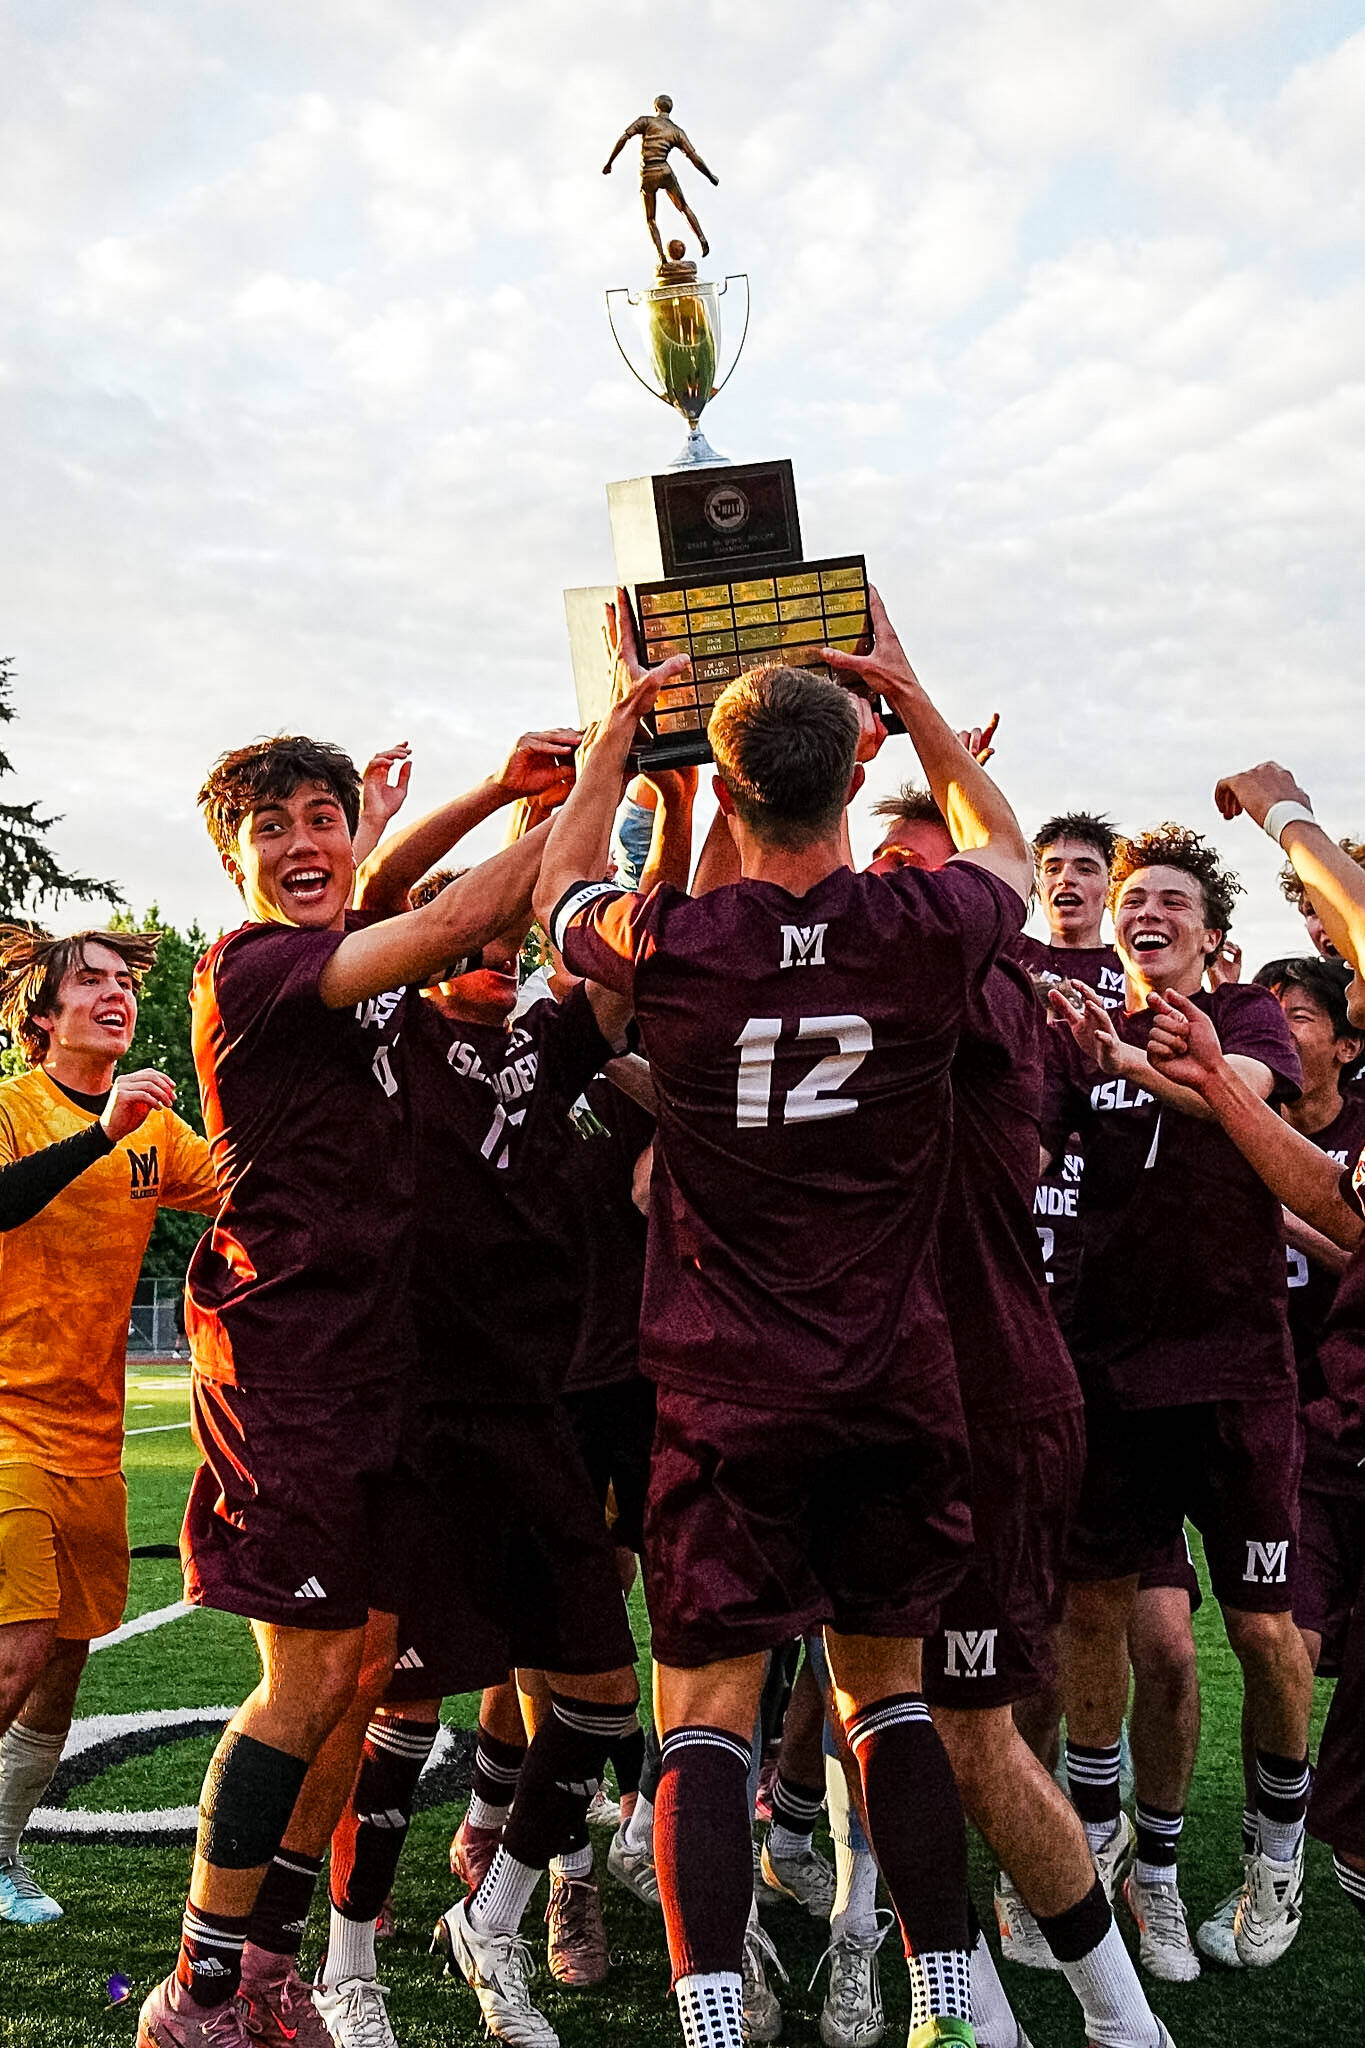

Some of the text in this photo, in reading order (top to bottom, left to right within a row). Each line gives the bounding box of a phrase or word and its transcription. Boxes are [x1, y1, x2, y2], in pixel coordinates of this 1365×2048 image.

[446, 1040, 540, 1103] ISLDE
[733, 1014, 874, 1128] 12
[1033, 1185, 1079, 1217] NDE
